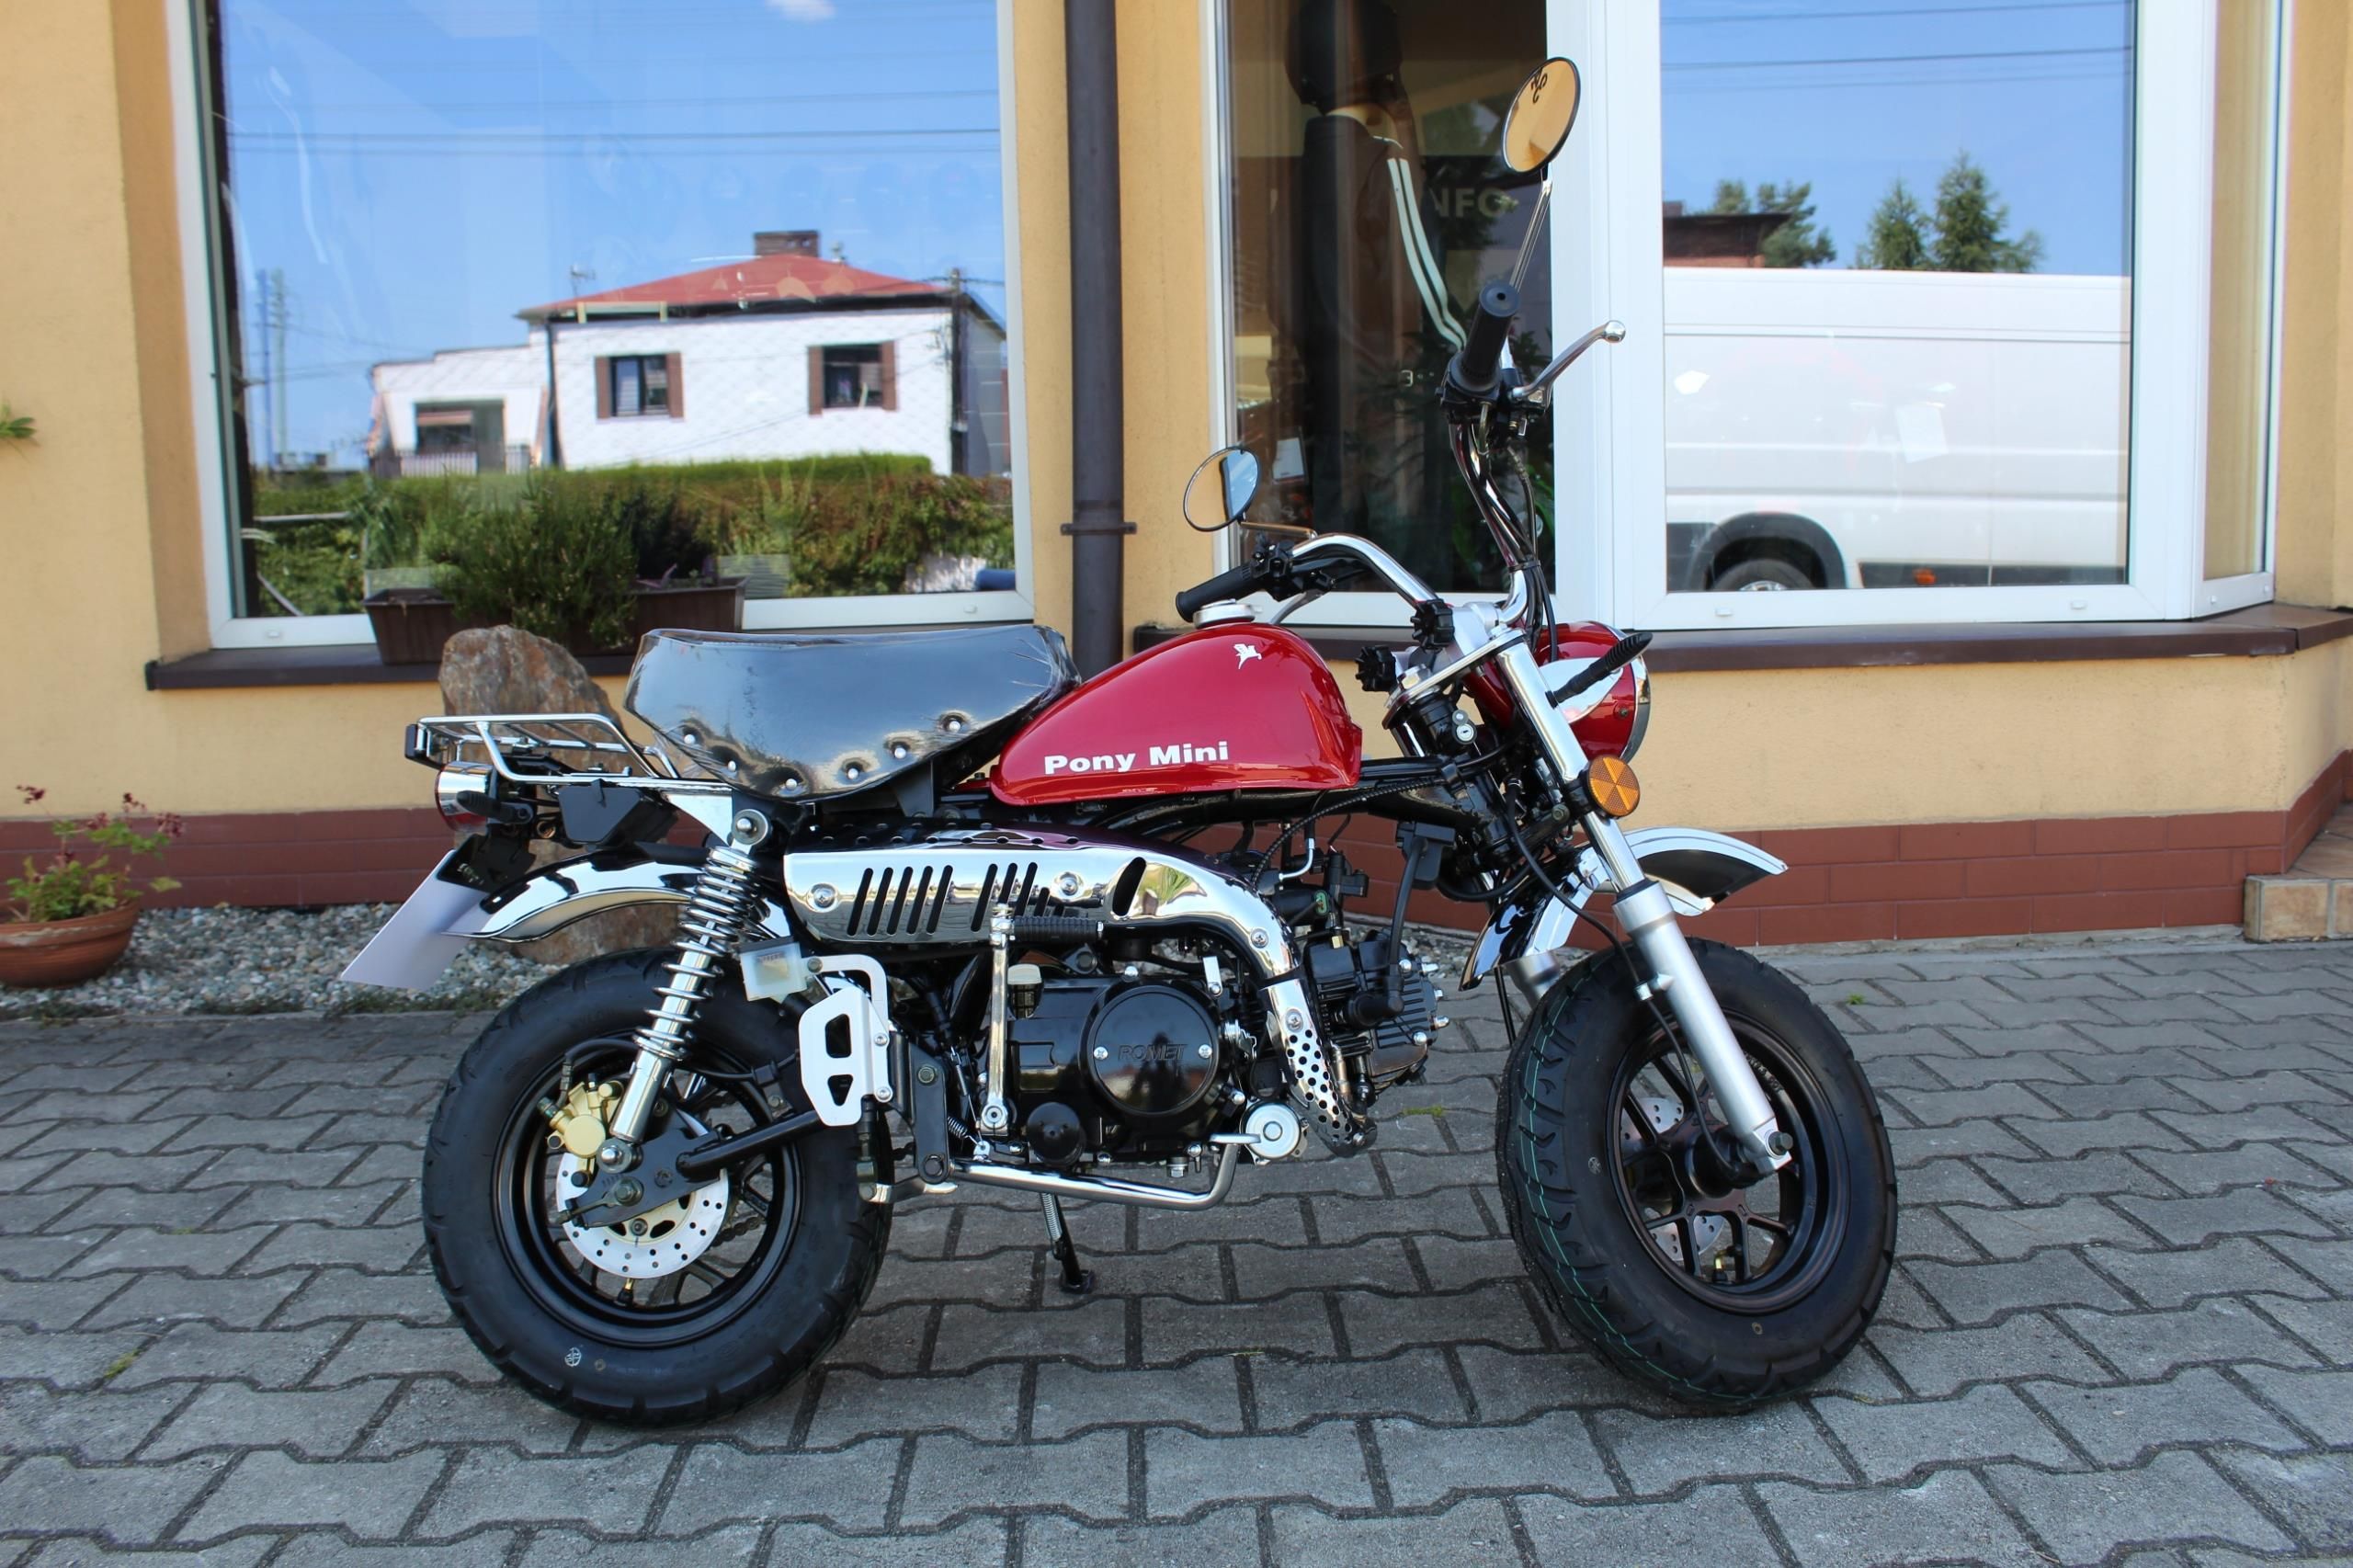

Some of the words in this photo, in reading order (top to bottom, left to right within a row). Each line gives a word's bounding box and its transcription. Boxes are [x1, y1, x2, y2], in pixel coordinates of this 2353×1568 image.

[1427, 187, 1506, 219] NFO
[1043, 752, 1136, 776] Pony
[1149, 740, 1230, 767] Mini
[1118, 1043, 1188, 1062] ROMET
